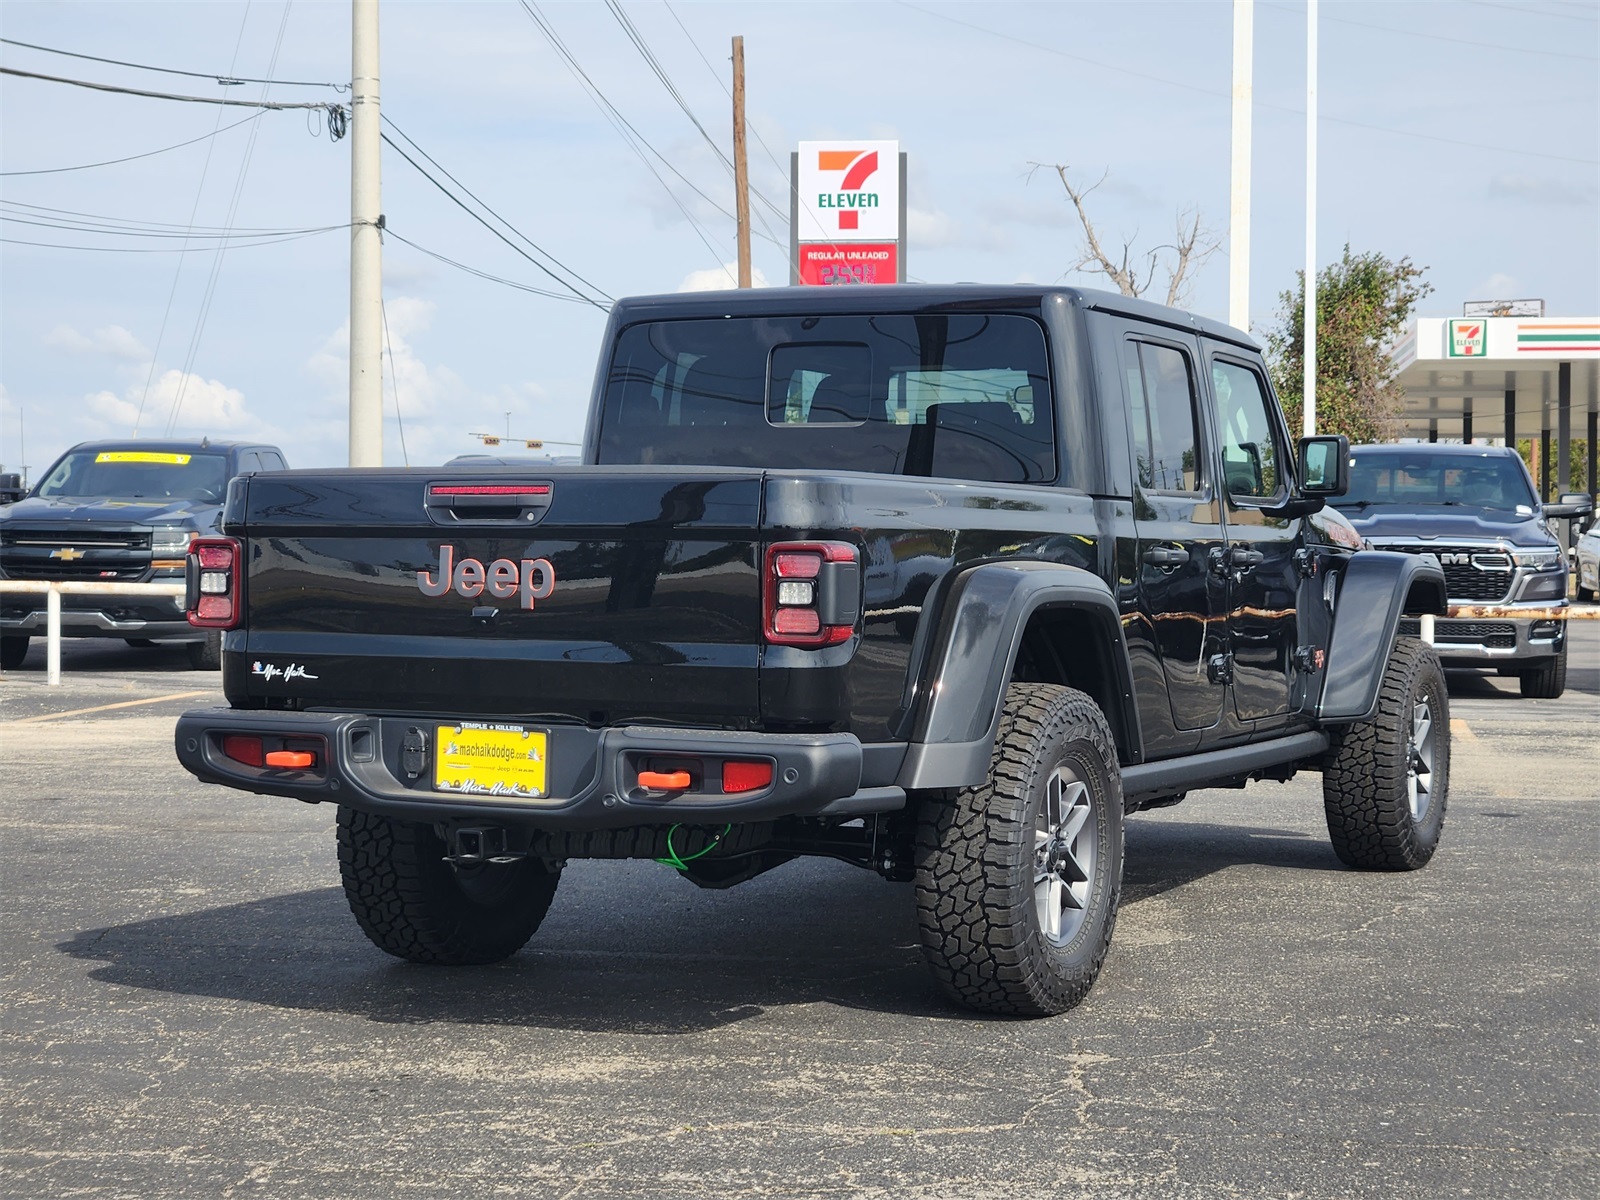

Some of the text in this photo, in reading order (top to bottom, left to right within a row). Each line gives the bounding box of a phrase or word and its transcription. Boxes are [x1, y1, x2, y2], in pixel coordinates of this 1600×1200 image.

[807, 251, 889, 260] REGULAR UNLEADED
[416, 544, 556, 610] Jeep
[260, 664, 284, 682] Mac
[460, 722, 524, 732] TEMPLE KILLEEN
[459, 743, 527, 761] machaikdodge.com
[456, 779, 530, 796] Mac Haik
